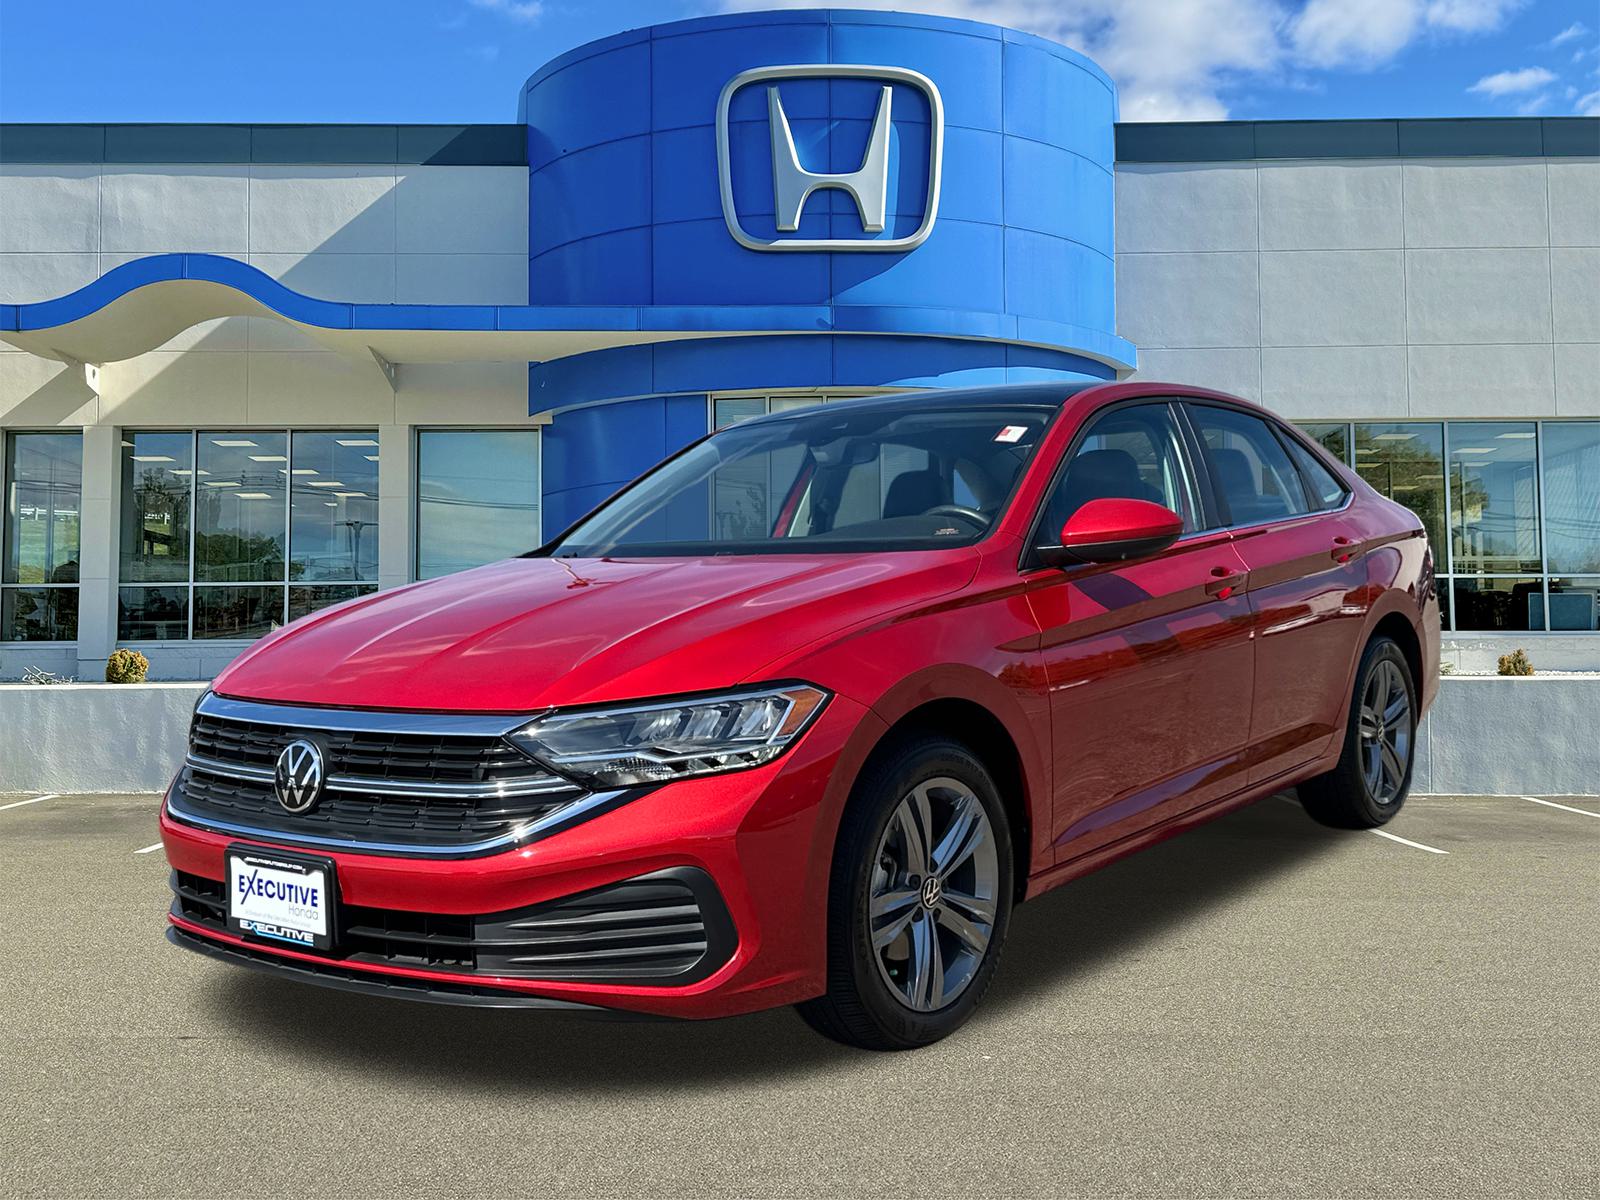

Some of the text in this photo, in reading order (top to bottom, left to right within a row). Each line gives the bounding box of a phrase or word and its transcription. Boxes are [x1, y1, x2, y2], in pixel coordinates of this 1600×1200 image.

[239, 869, 318, 907] EXECUTIVE
[288, 904, 319, 920] Honda
[240, 919, 313, 943] EXECUTIVE
